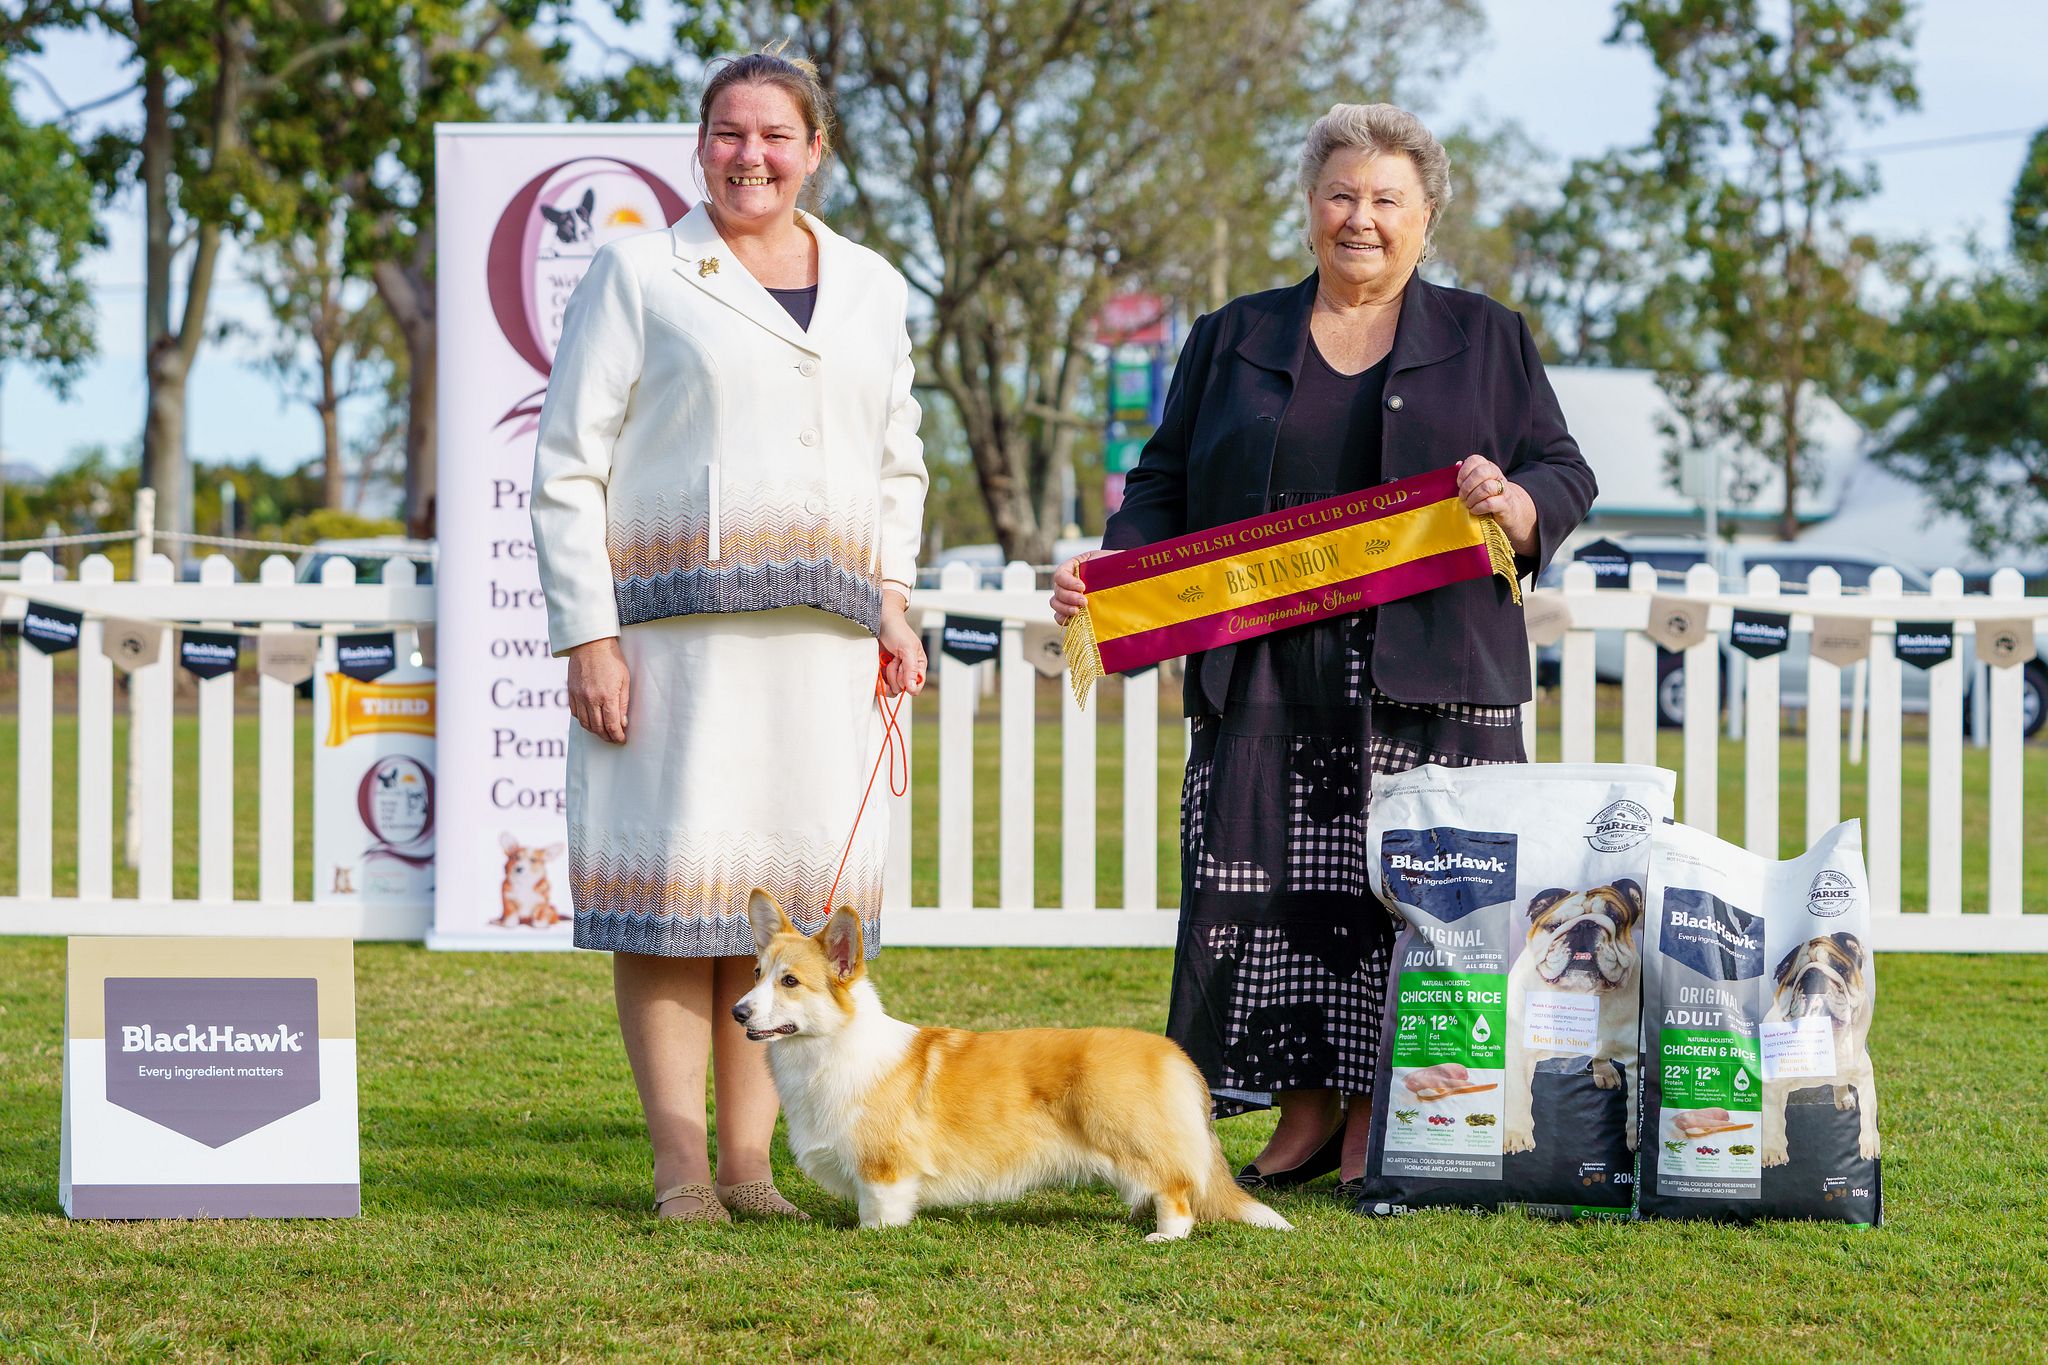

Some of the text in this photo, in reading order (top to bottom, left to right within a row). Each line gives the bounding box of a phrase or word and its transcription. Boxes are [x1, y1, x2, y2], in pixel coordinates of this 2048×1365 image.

[493, 480, 530, 508] Pr
[1138, 490, 1408, 569] THE WELSH CORGI CLUB OF QLD
[491, 539, 537, 559] res
[1224, 543, 1340, 595] BEST IN SHOW
[490, 580, 544, 608] bre
[1228, 589, 1362, 635] Championship Show
[491, 678, 569, 709] Card
[361, 698, 429, 716] THIRD
[492, 729, 565, 758] Pem
[491, 777, 566, 815] Corg
[1595, 821, 1647, 834] PARKES
[1391, 853, 1506, 873] BlackHawk
[1401, 875, 1493, 886] Every ingredient matters
[1811, 890, 1849, 900] PARKES
[1419, 926, 1485, 947] RIGINAL
[1671, 911, 1756, 950] BlackHawk
[1678, 933, 1697, 942] Every
[1404, 950, 1456, 967] ADULT
[1401, 991, 1501, 1003] CHICKEN & RICE
[1680, 986, 1740, 1014] ORIGINAL
[1401, 1015, 1458, 1030] 22% 12%
[1664, 1010, 1723, 1026] ADULT
[122, 1024, 302, 1052] BlackHawk
[1533, 1034, 1589, 1047] Best in Show
[1664, 1045, 1756, 1061] CHICKEN & RICE
[139, 1065, 284, 1080] Every ingredient matters
[1665, 1065, 1720, 1080] 22% 12%
[1614, 1173, 1636, 1183] 20k
[1852, 1189, 1869, 1197] 10kg
